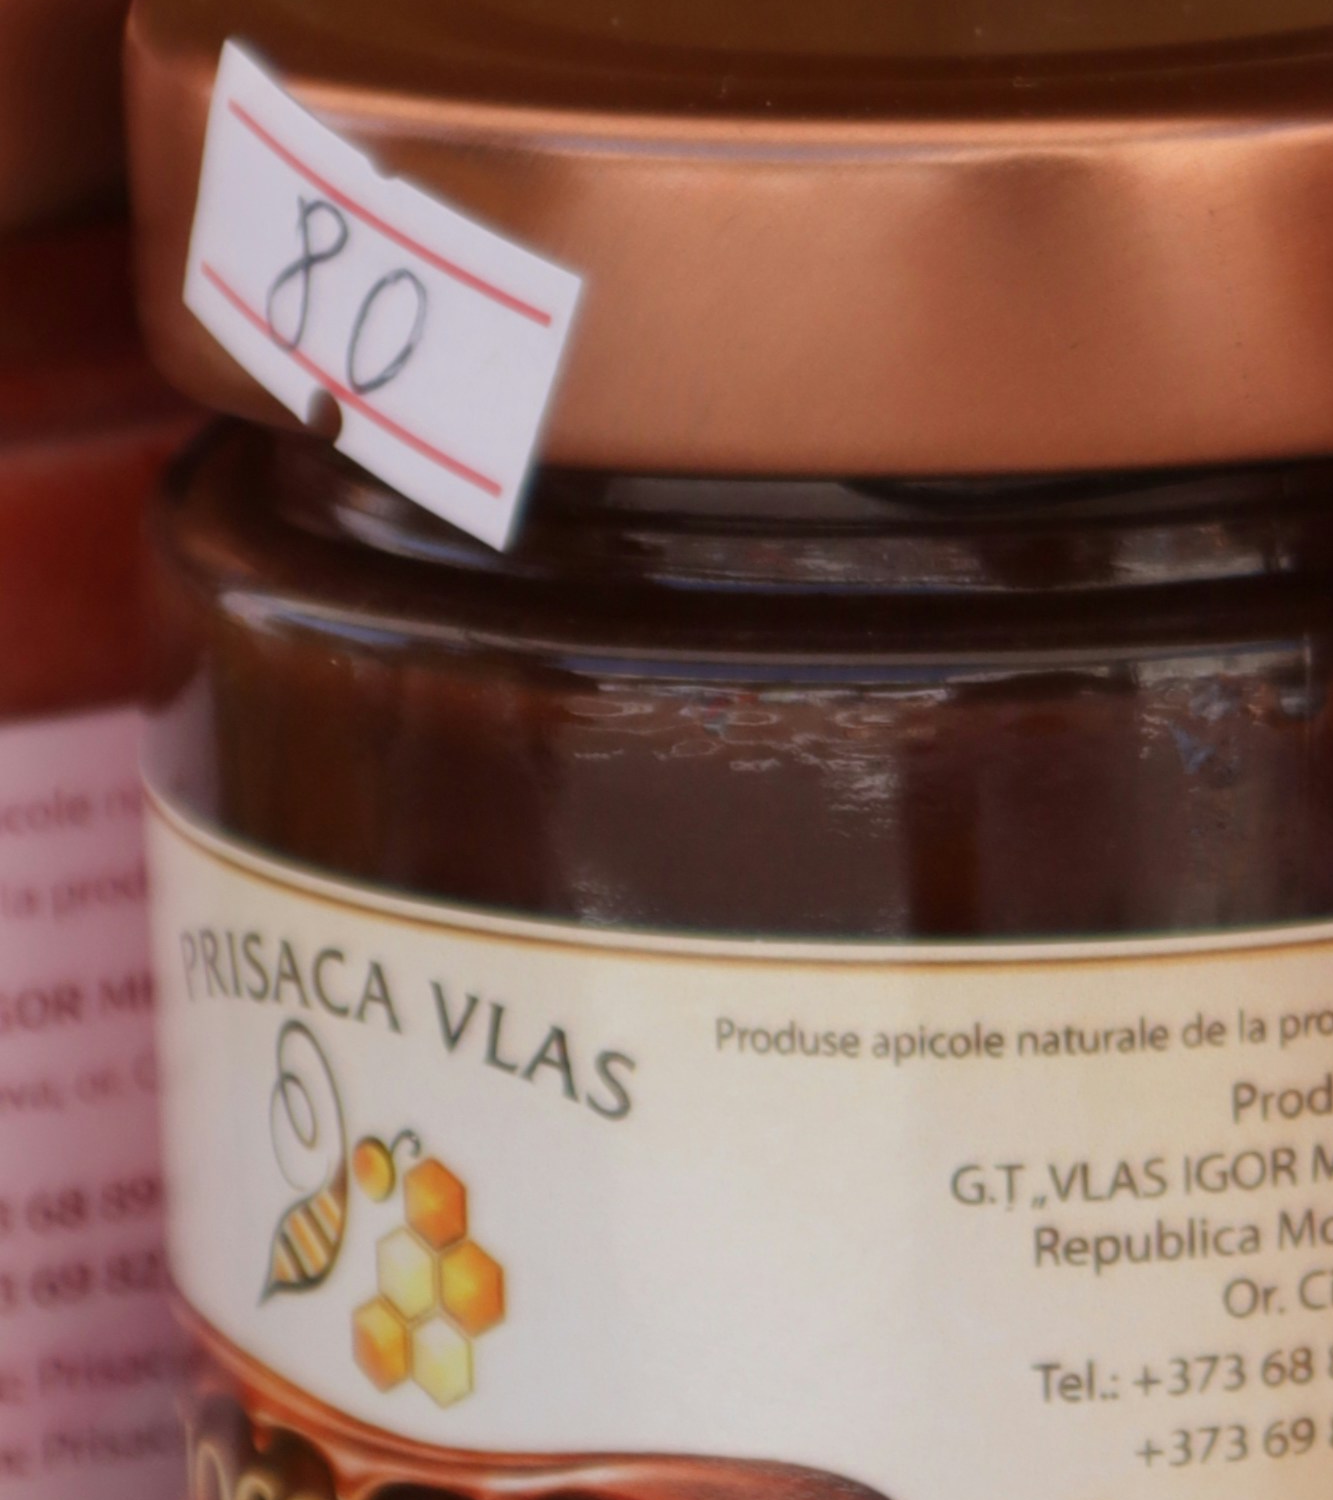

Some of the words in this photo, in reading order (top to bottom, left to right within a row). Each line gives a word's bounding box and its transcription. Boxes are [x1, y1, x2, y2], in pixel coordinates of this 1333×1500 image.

[266, 196, 428, 396] 80
[180, 929, 402, 1034] PRISACA
[430, 980, 637, 1122] VLAS
[715, 1017, 861, 1057] Produse
[872, 1021, 1005, 1066] apicole
[1017, 1016, 1170, 1056] naturale
[1181, 1012, 1226, 1048] de
[1239, 1009, 1267, 1043] la
[1184, 1146, 1298, 1195] IGOR
[1033, 1218, 1262, 1276] Republica
[1222, 1276, 1287, 1319] Or.
[1032, 1358, 1120, 1404] Tel.:
[1132, 1353, 1247, 1398] +373
[1260, 1346, 1314, 1389] 68
[1135, 1424, 1250, 1468] +373
[1262, 1417, 1317, 1460] 69
